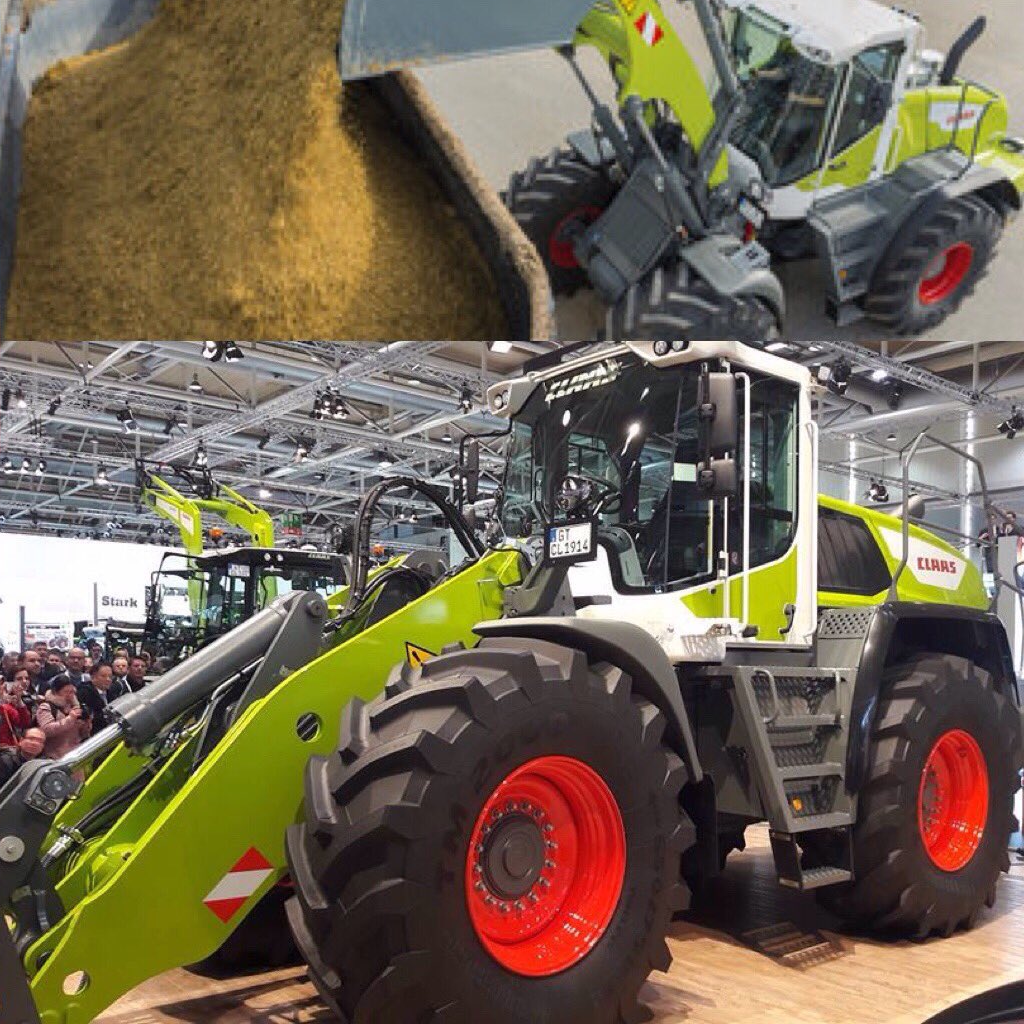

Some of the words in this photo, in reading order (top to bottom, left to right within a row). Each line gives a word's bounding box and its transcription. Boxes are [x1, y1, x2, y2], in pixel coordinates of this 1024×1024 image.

[558, 528, 570, 542] GT
[917, 557, 956, 574] CLAAS
[101, 595, 138, 608] Stark
